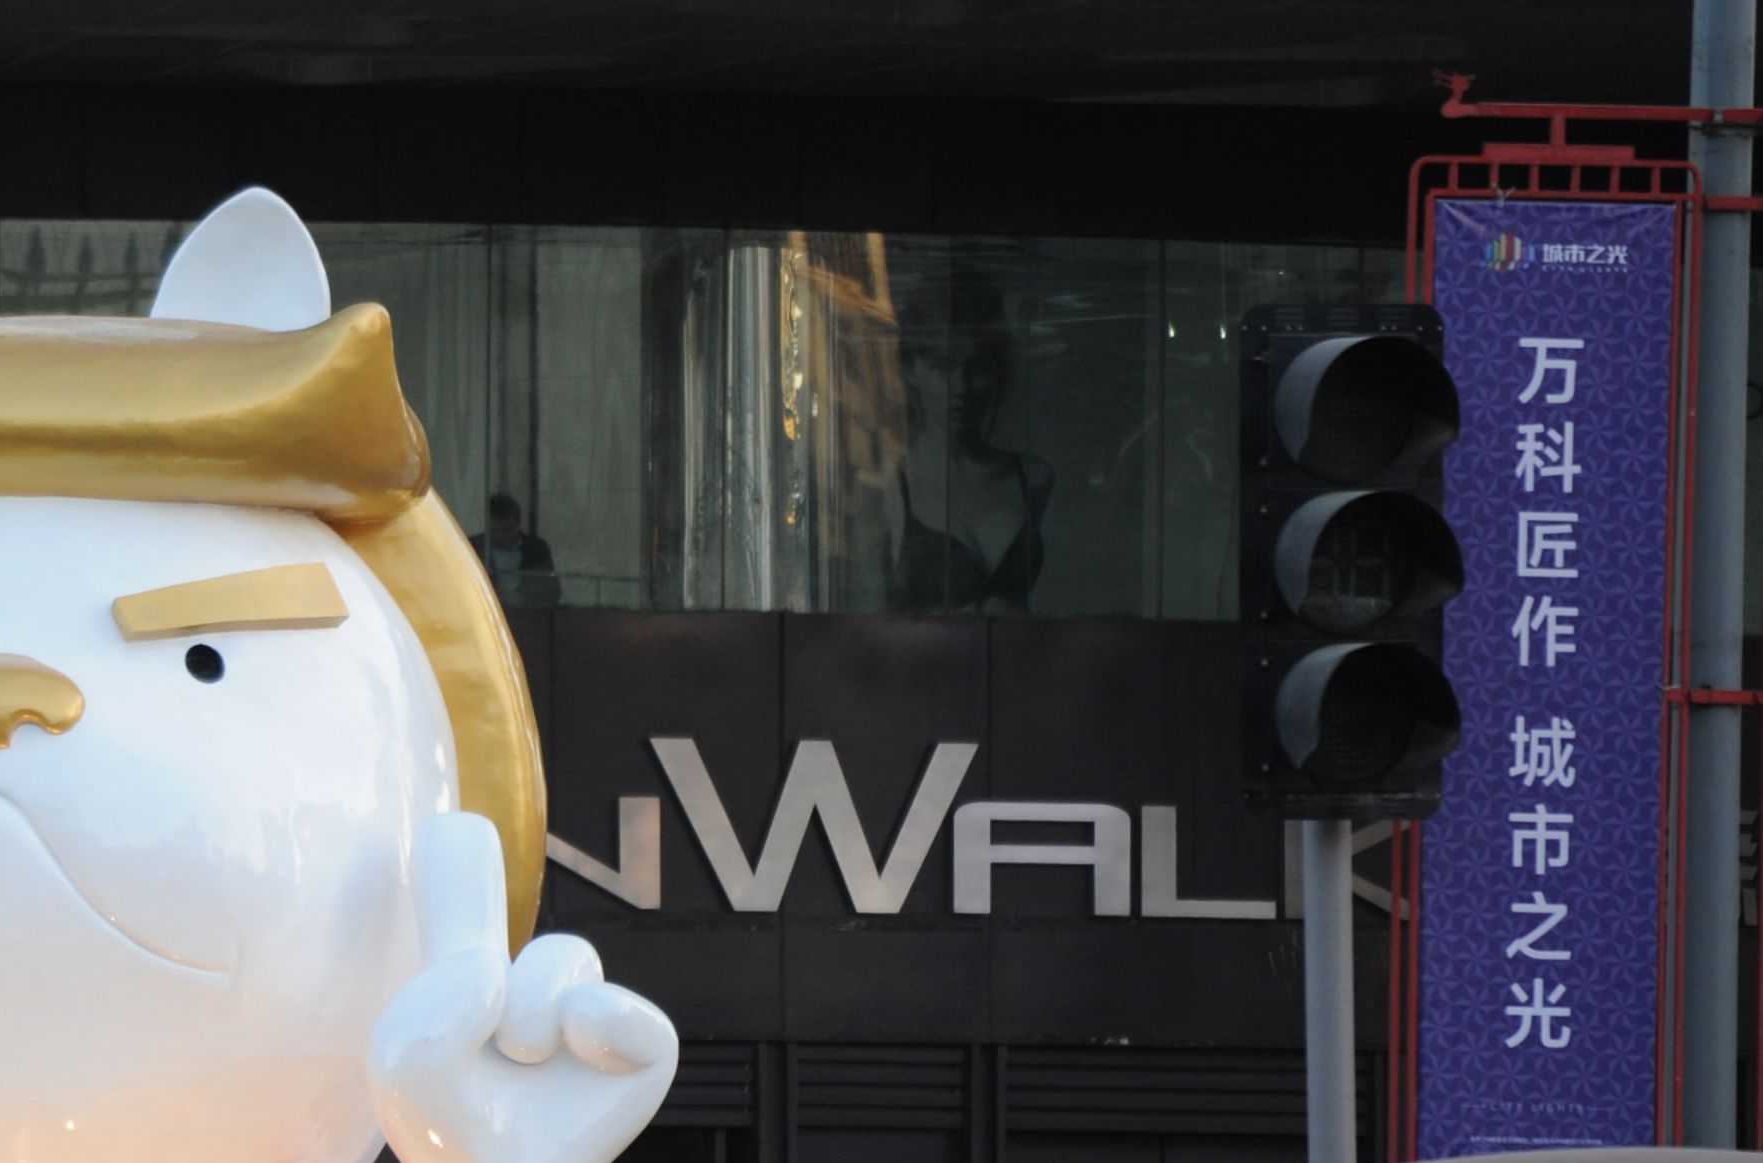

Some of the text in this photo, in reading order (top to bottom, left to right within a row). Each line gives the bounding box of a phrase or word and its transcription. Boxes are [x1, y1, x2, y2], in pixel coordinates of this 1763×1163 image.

[1542, 243, 1629, 265] 城市之光
[1511, 336, 1585, 668] 万科匠作
[1504, 715, 1577, 1050] 城市之光
